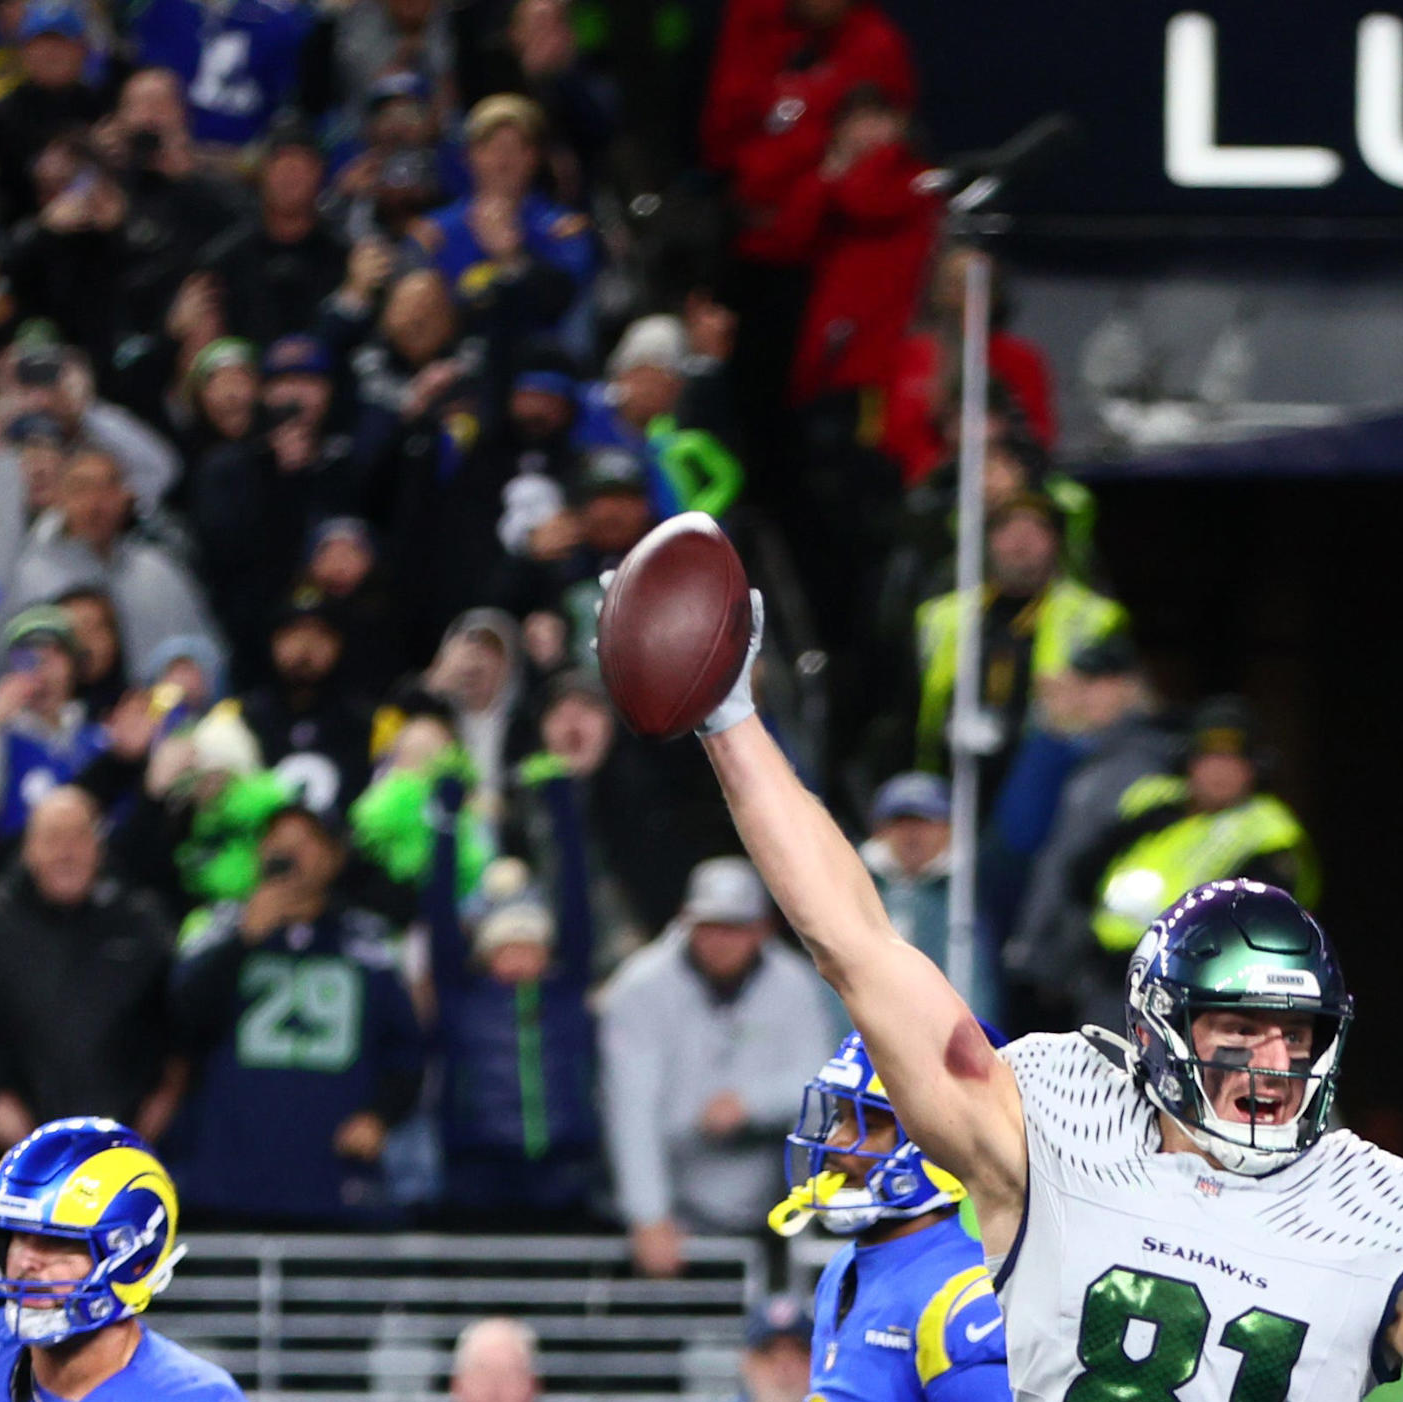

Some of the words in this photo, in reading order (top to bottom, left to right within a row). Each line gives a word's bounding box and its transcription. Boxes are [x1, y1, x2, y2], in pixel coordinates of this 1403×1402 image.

[235, 956, 364, 1073] 29
[1141, 1236, 1269, 1290] SEAHAWKS
[864, 1328, 912, 1351] RAMS
